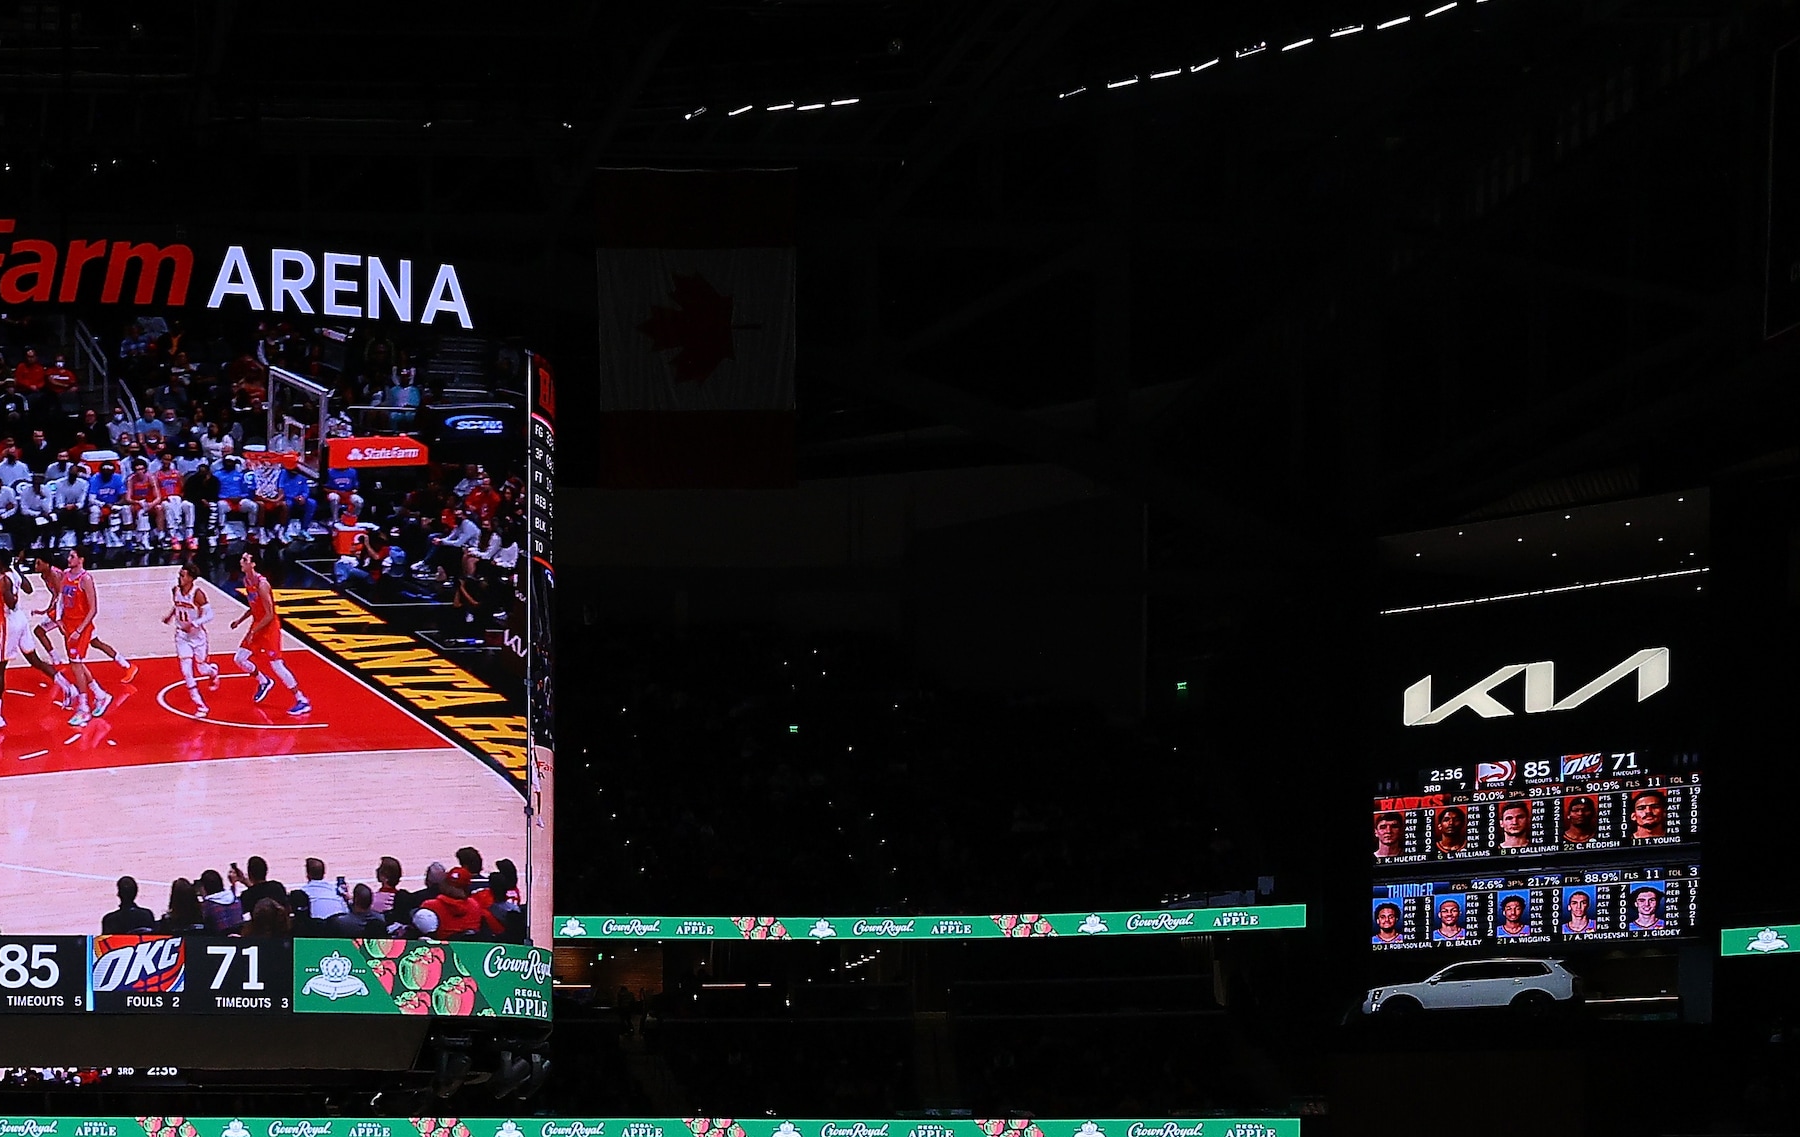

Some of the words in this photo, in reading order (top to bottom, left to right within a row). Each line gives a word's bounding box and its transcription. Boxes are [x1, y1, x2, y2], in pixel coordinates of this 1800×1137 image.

[207, 245, 475, 329] ARENA
[1431, 768, 1463, 781] 2:36
[1523, 760, 1550, 777] 85
[1611, 752, 1638, 770] 71
[1424, 785, 1441, 793] 3RD
[1473, 791, 1505, 802] 50.0%
[1528, 785, 1562, 797] 39.1%
[1586, 780, 1620, 792] 90.9%
[1471, 880, 1504, 890] 42.6%
[1527, 877, 1560, 888] 21.7%
[1584, 872, 1619, 883] 88.9%
[1127, 914, 1159, 932] Crown
[1157, 914, 1194, 933] Royal
[1214, 917, 1259, 927] APPLE
[93, 937, 181, 991] OKC
[206, 945, 265, 990] 71
[483, 945, 530, 978] Crown
[6, 995, 64, 1007] TIMEOUTS
[74, 995, 82, 1007] 5
[126, 995, 164, 1008] FOULS
[172, 995, 180, 1008] 2
[514, 988, 542, 998] REGAL
[215, 996, 272, 1008] TIMEOUTS
[281, 997, 289, 1009] 3
[501, 997, 548, 1018] APPLE
[76, 1126, 117, 1136] APPLE
